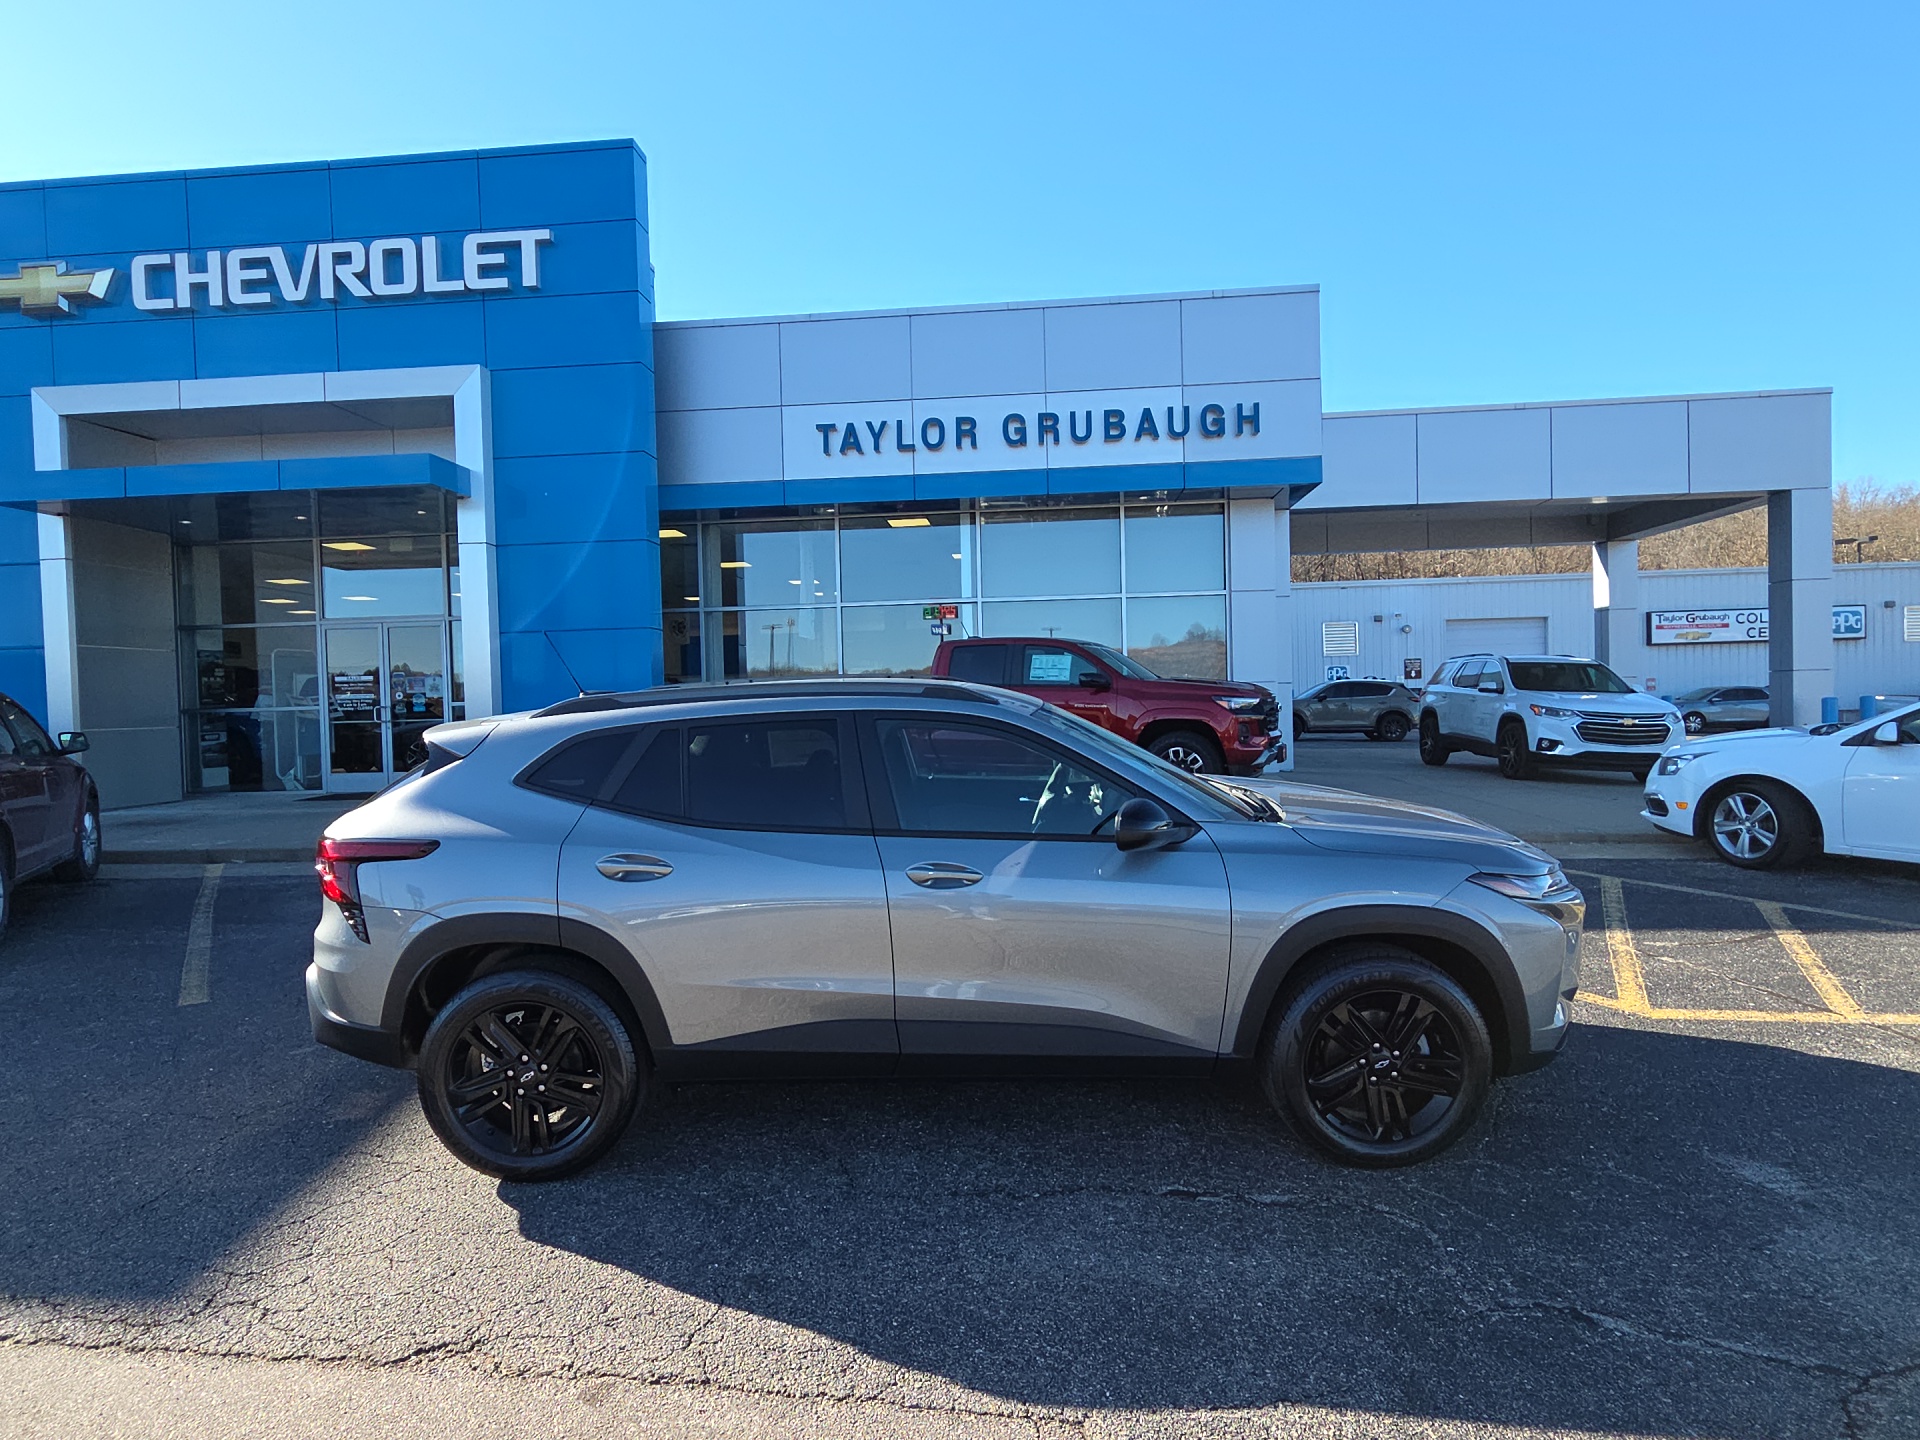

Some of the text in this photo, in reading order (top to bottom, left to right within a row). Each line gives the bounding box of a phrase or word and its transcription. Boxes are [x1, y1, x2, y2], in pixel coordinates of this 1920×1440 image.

[131, 228, 554, 311] CHEVROLET
[816, 402, 1260, 456] TAYLOR GRUBAUGH
[1655, 612, 1730, 624] Taylor Grubaugh
[1735, 612, 1768, 624] COL
[1832, 612, 1861, 633] PPG
[1746, 627, 1768, 638] CE
[1328, 667, 1347, 680] PPG
